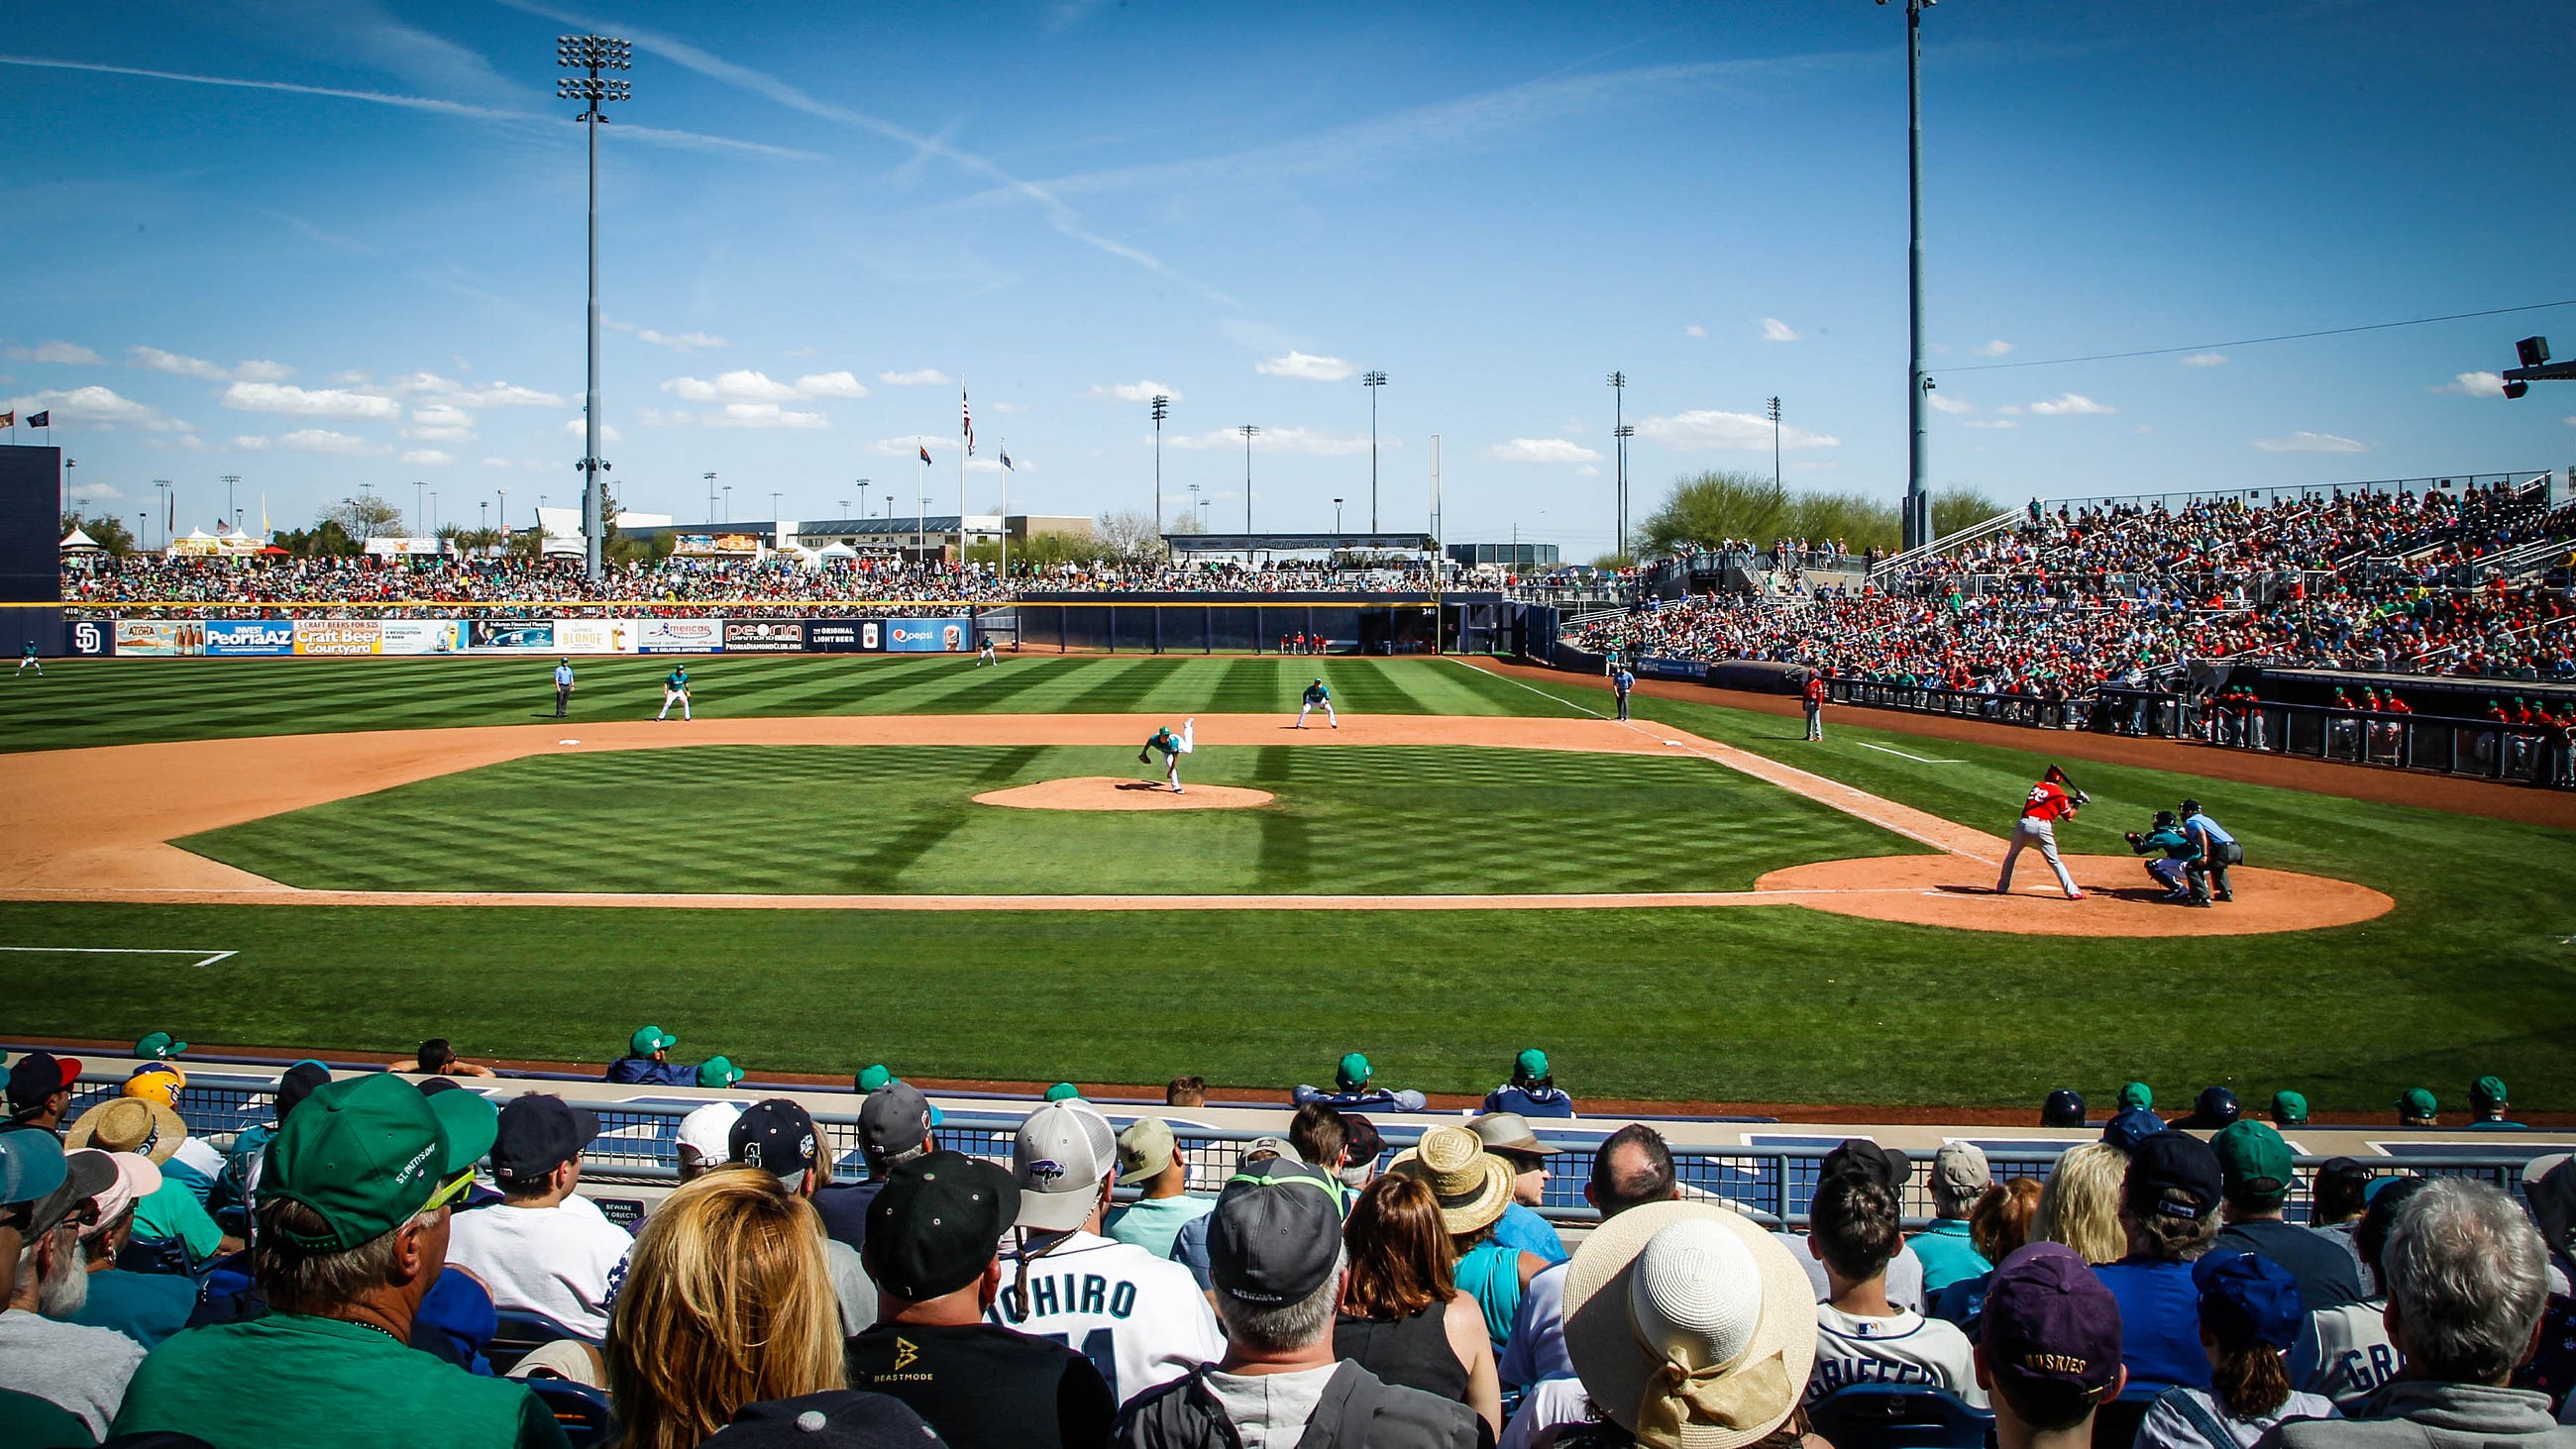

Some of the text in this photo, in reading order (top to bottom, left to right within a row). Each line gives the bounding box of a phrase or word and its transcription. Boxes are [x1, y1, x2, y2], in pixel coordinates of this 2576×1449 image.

[64, 606, 79, 615] 410
[128, 625, 156, 636] ALOHA
[297, 628, 380, 643] Craft Beer
[909, 631, 933, 642] pepsi
[207, 630, 292, 646] PeoriaAZ
[563, 633, 603, 645] BLONDE
[305, 642, 372, 656] Courtyard
[2024, 1353, 2087, 1375] HUSKIES
[874, 1373, 933, 1383] BEASTMODE
